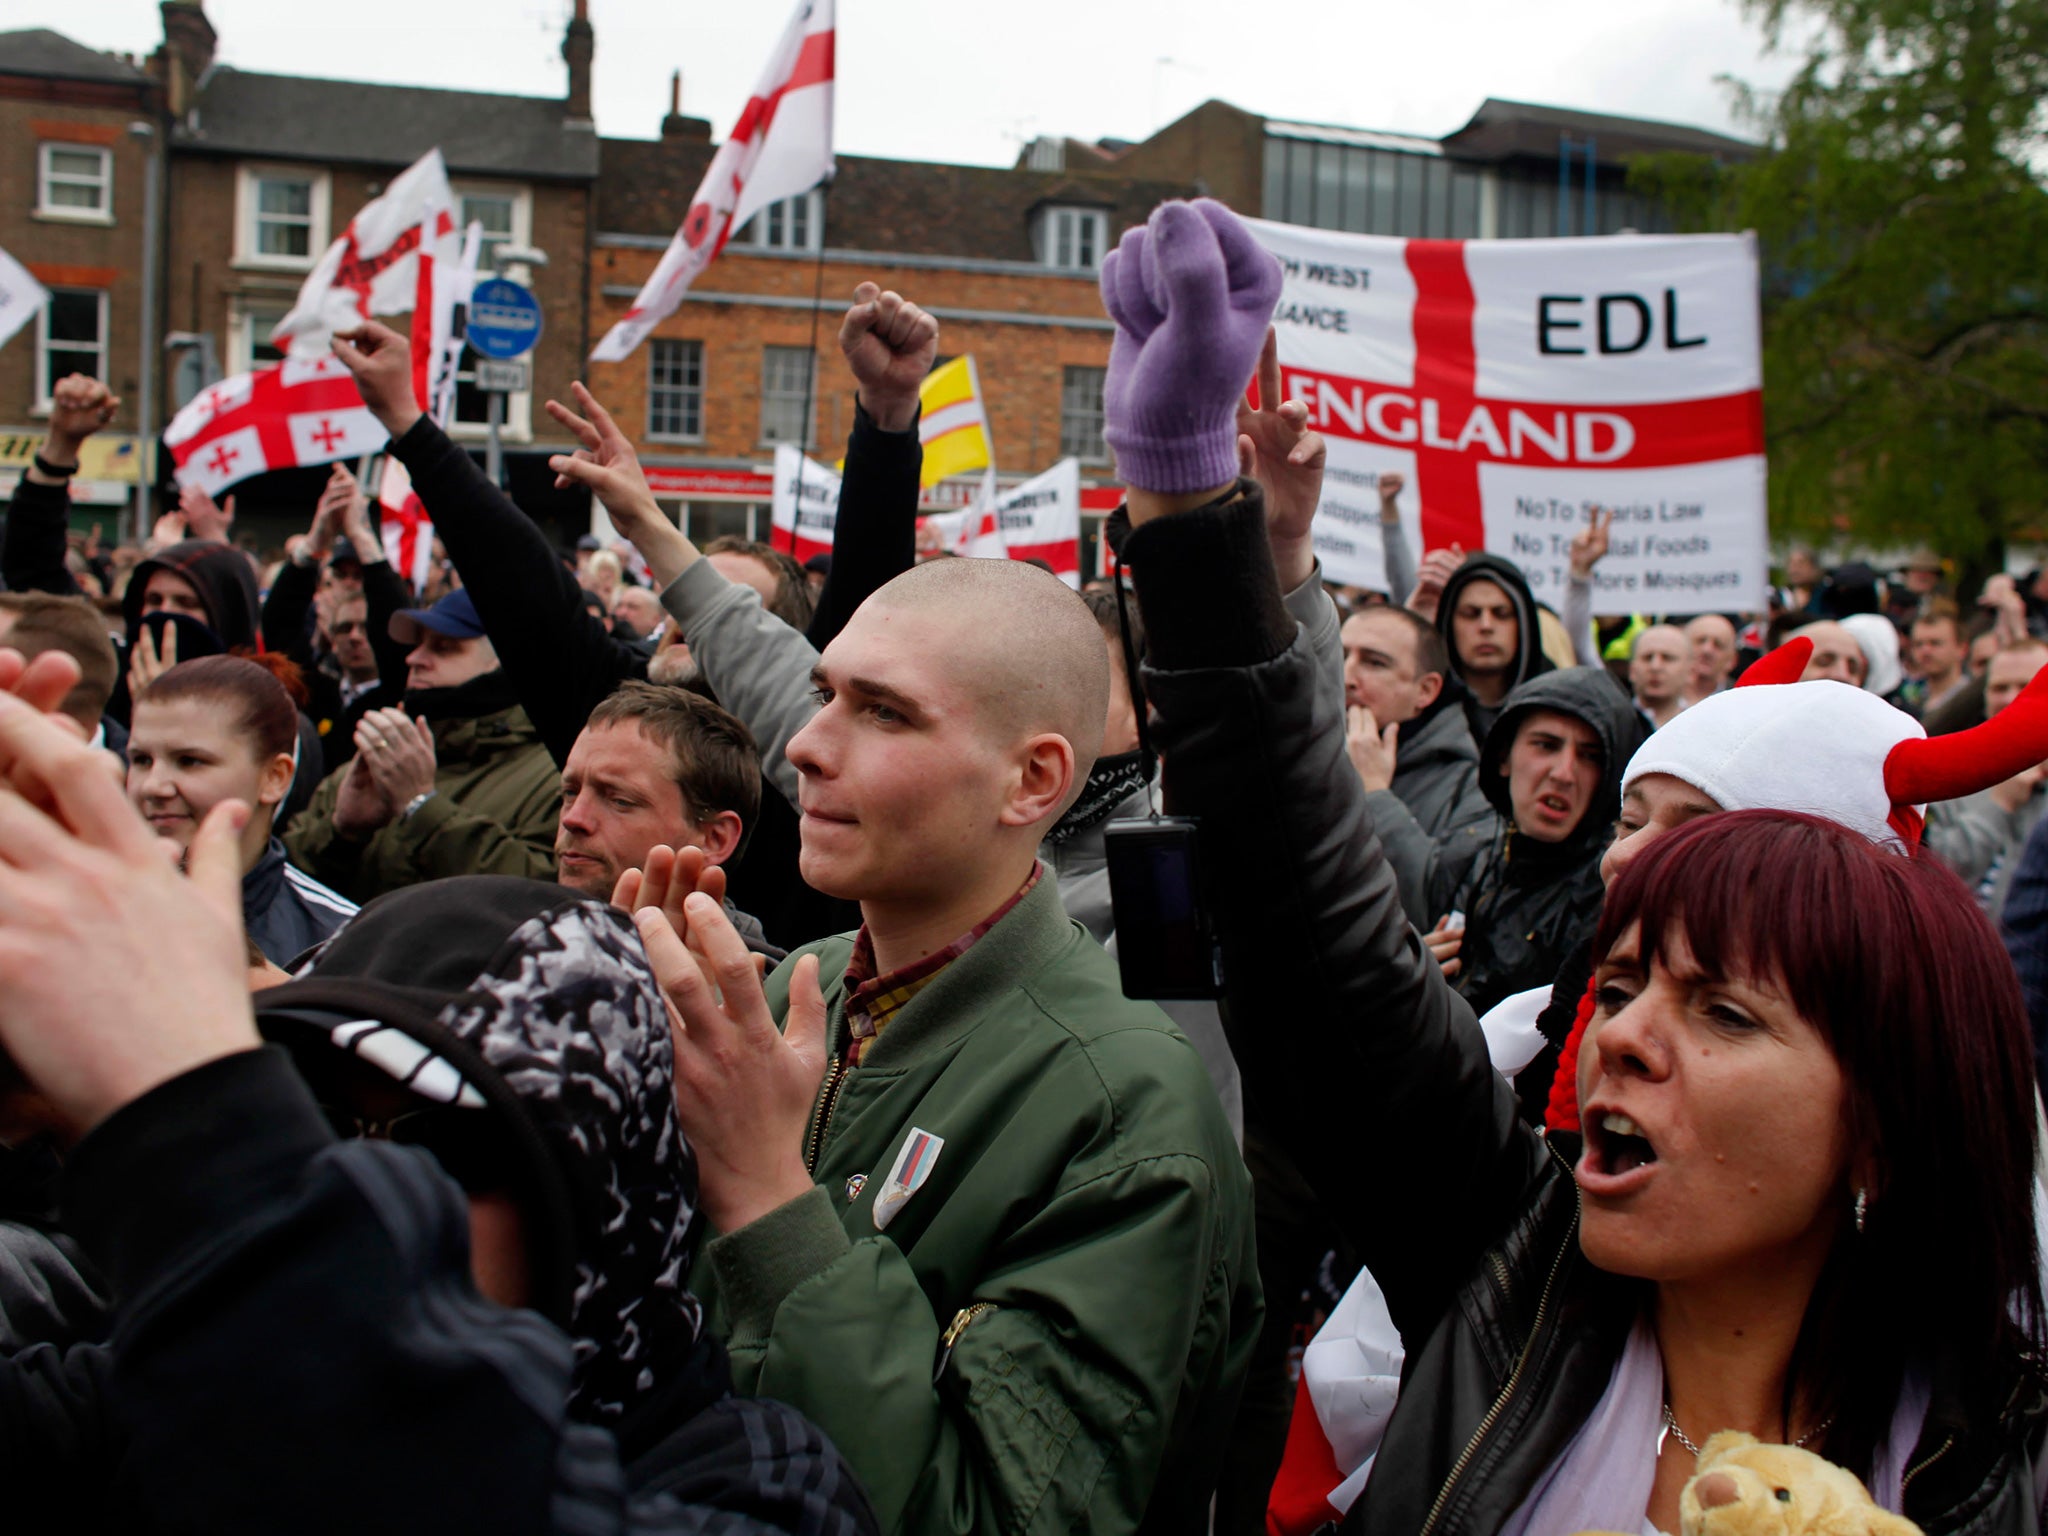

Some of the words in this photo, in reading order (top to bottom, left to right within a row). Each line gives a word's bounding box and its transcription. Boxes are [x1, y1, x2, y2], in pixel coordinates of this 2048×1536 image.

[1306, 261, 1371, 291] WEST
[1273, 301, 1349, 333] IANCE
[1539, 287, 1707, 355] EDL
[1288, 374, 1635, 462] ENGLAND
[1660, 499, 1703, 522] Law
[1513, 533, 1544, 556] No
[1644, 535, 1709, 556] Foods
[1645, 569, 1741, 594] Mosques
